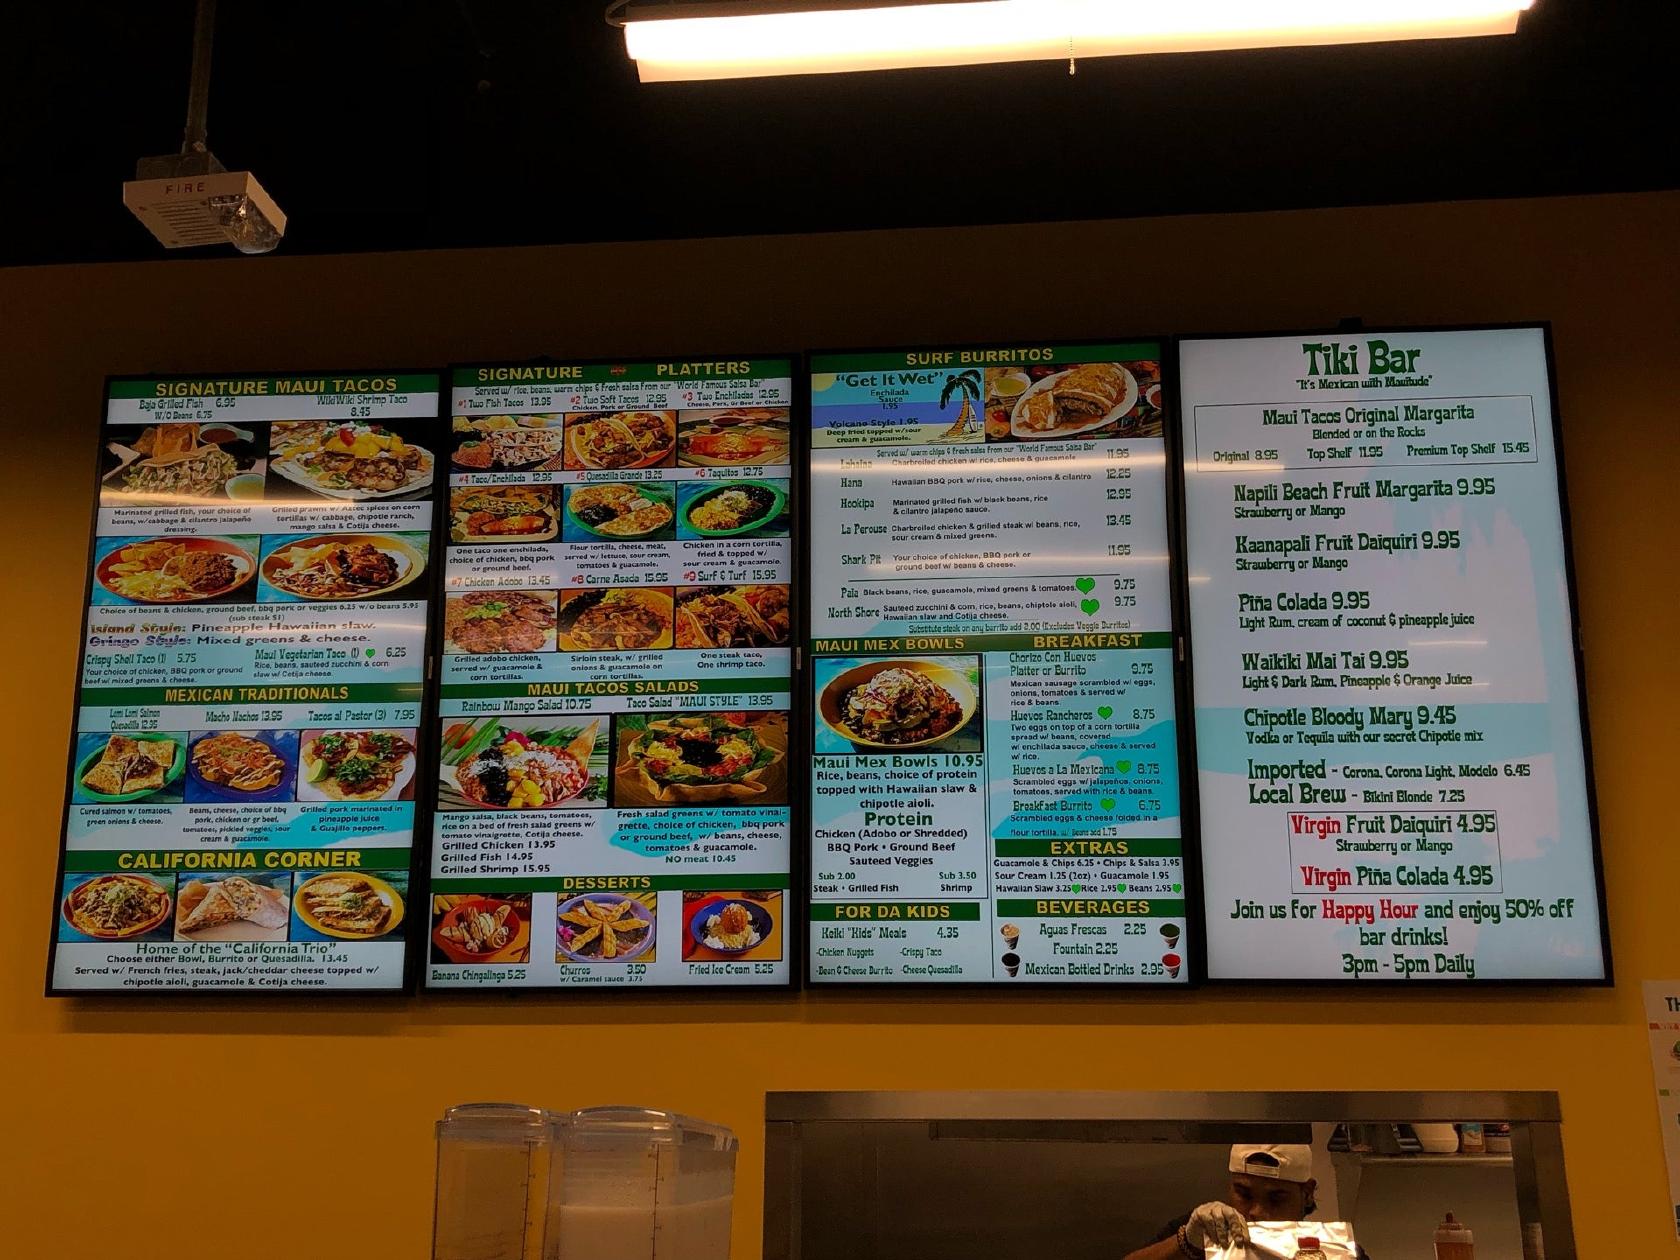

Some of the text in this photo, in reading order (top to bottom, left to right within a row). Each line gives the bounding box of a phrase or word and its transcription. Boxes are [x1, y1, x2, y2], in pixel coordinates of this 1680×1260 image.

[166, 183, 205, 194] FIRE
[906, 349, 1053, 365] SURF BURRITOS
[1303, 340, 1420, 376] Tiki Bar
[478, 362, 750, 381] SIGNATURE PLATTERS
[836, 372, 942, 388] "Get It Wet"
[1318, 377, 1359, 389] Mexican
[1362, 376, 1382, 388] with
[156, 378, 397, 397] SIGNATURE MAUI TACOS
[158, 398, 183, 410] Grilled
[186, 398, 203, 409] Fish
[1262, 405, 1474, 425] Maui Tacos Original Margarita
[1307, 446, 1383, 461] Top Shelf 11.95
[1407, 442, 1529, 456] Premium Top Shelf 15.45
[1234, 478, 1495, 505] Napili Beach Fruit Margarita 9.95
[1234, 505, 1345, 520] Strawberry or Mango
[1236, 531, 1460, 557] Kaanapali Fruit Daiquiri 9.95
[698, 571, 717, 581] Surf
[720, 570, 725, 581] &
[728, 570, 747, 580] Turf
[753, 570, 777, 580] 15.95
[1239, 592, 1369, 612] Piña Colada 9.95
[192, 622, 264, 634] Pineapple
[269, 622, 336, 631] Hawaiian
[816, 638, 965, 651] MAUI MEX BOWLS
[1033, 634, 1141, 648] BREAKFAST
[1243, 651, 1408, 671] Waikiki Mai Tai 9.95
[166, 687, 349, 703] MEXICAN TRADITIONALS
[528, 681, 699, 696] MAUI TACOS SALADS
[462, 699, 591, 713] Rainbow Mango Salad 10.75
[309, 709, 415, 721] Tacos al Pastor (3) 7.95
[1244, 705, 1456, 729] Chipotle Bloody Mary 9.45
[814, 755, 983, 769] Maui Mex Bowls 10.95
[1249, 783, 1346, 804] Local Brew
[865, 812, 933, 826] Protein
[1291, 814, 1495, 839] Virgin Fruit Daiquiri 4.95
[442, 839, 555, 850] Grilled Chicken 13.95
[1051, 842, 1128, 854] EXTRAS
[119, 851, 361, 869] CALIFORNIA CORNER
[441, 853, 533, 862] Grilled Fish 14.95
[666, 854, 736, 863] NO meat 10.45
[1052, 860, 1075, 868] Chips
[1103, 859, 1126, 867] Chips
[564, 876, 650, 889] DESSERTS
[1301, 866, 1493, 891] Virgin Piña Colada 4.95
[835, 906, 949, 918] FOR DA KIDS
[1037, 901, 1150, 914] BEVERAGES
[1231, 900, 1265, 919] Join
[1269, 903, 1287, 919] us
[1322, 899, 1375, 924] Happy
[1379, 900, 1418, 918] Hour
[1424, 901, 1454, 919] and
[1459, 902, 1501, 923] enjoy
[1505, 899, 1544, 918] 50%
[1360, 926, 1448, 946] bar drinks!
[137, 942, 337, 954] Home of the "California Trio"
[689, 964, 773, 975] Fried Ice Cream 5.25
[1026, 963, 1164, 975] Mexican Bottled Drinks 2.95
[1342, 954, 1378, 977] 3pm
[1394, 954, 1429, 977] 5pm
[1434, 953, 1475, 978] Daily
